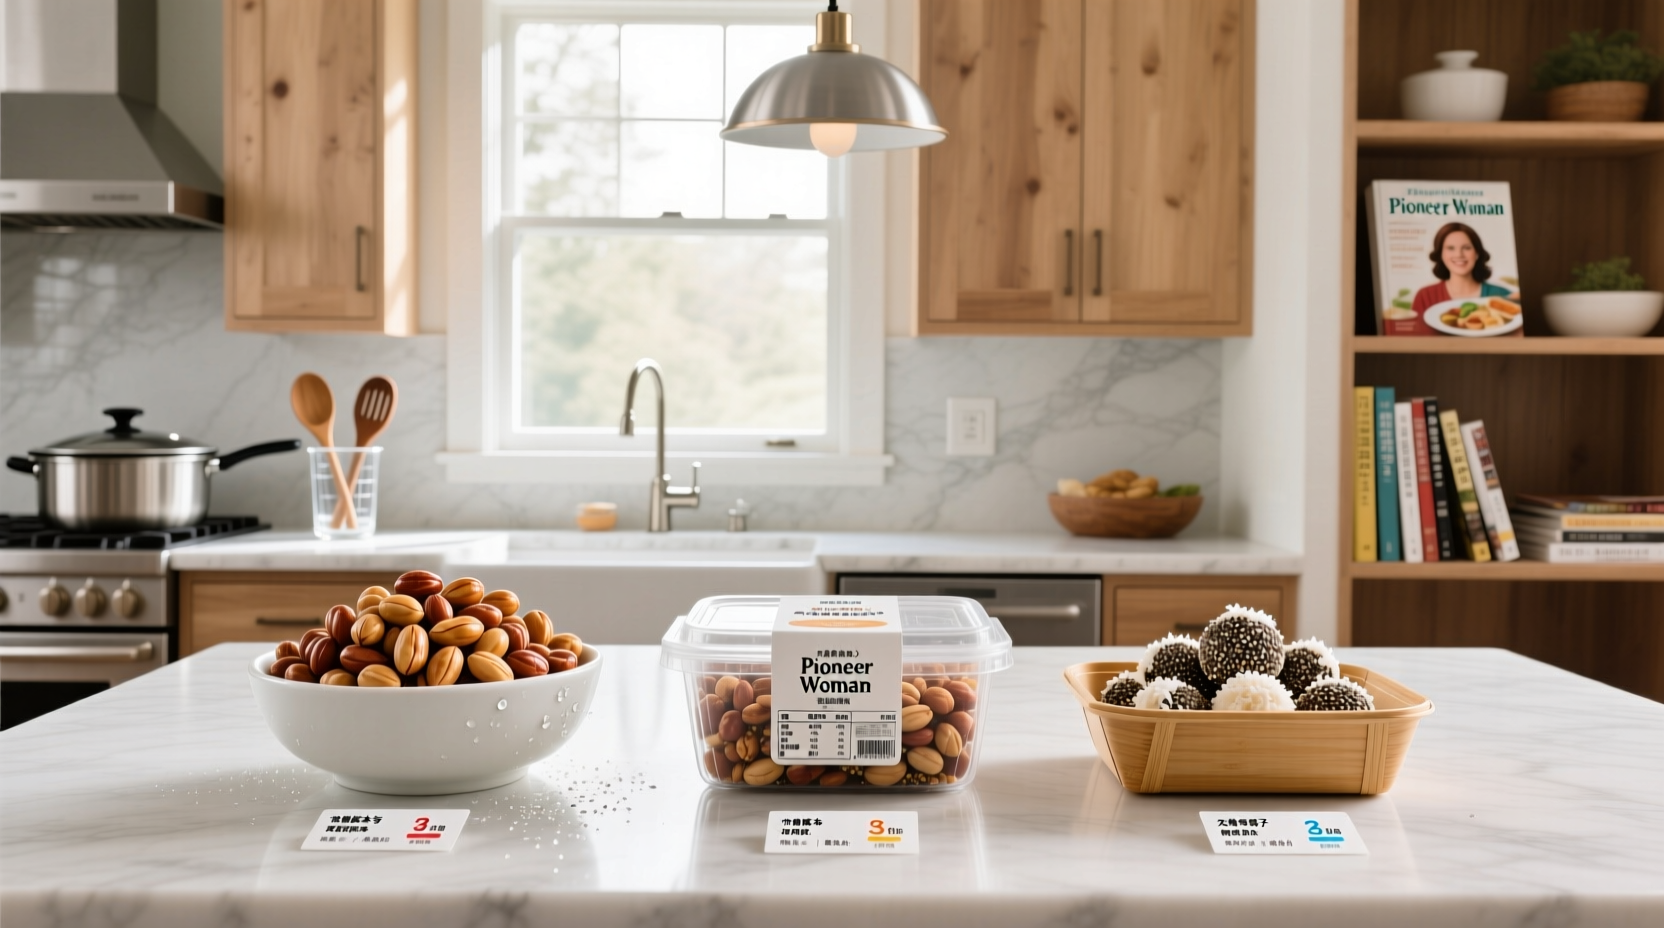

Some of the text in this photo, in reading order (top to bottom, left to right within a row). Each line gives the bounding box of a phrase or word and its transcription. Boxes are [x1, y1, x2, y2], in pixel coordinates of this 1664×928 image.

[1389, 198, 1449, 215] Pioneer
[801, 657, 873, 675] Pioneer
[800, 676, 871, 693] Woman
[413, 817, 429, 832] 3
